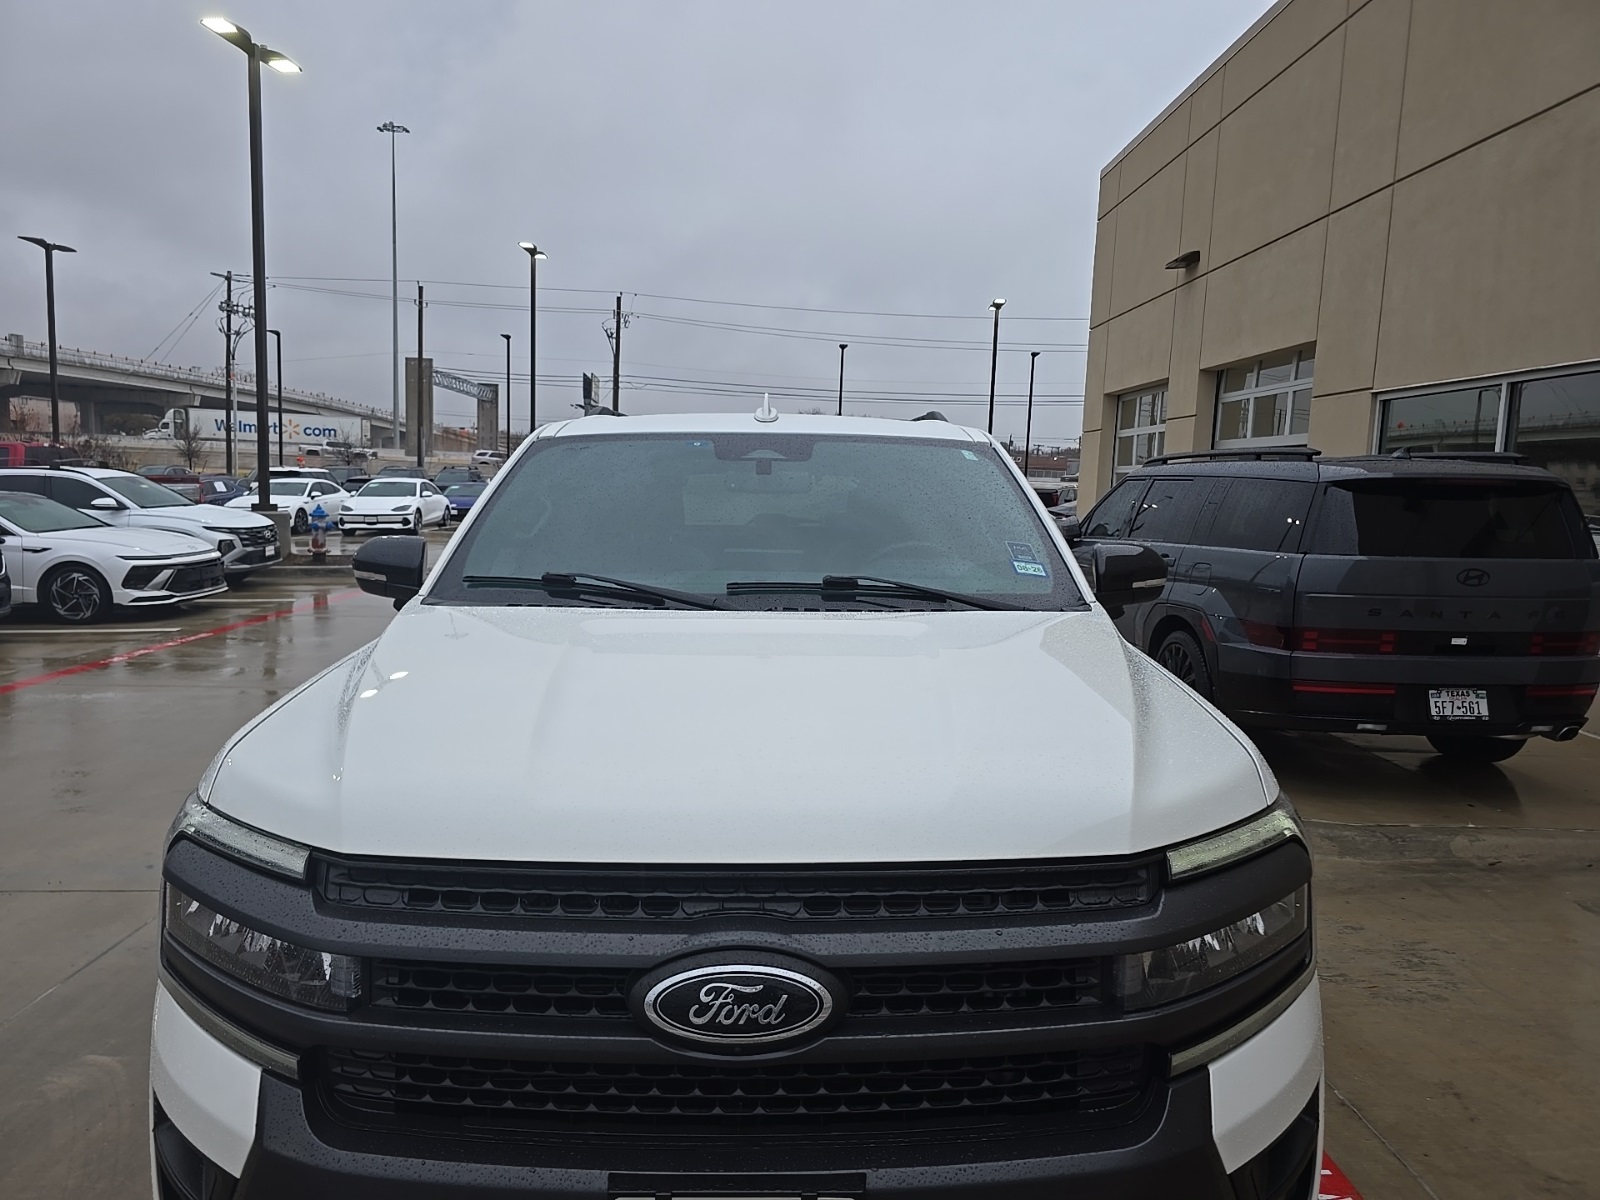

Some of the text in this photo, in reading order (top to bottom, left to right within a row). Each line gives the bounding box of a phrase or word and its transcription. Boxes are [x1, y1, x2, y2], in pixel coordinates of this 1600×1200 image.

[1367, 608, 1567, 620] SANTA FE
[688, 982, 789, 1025] Ford
